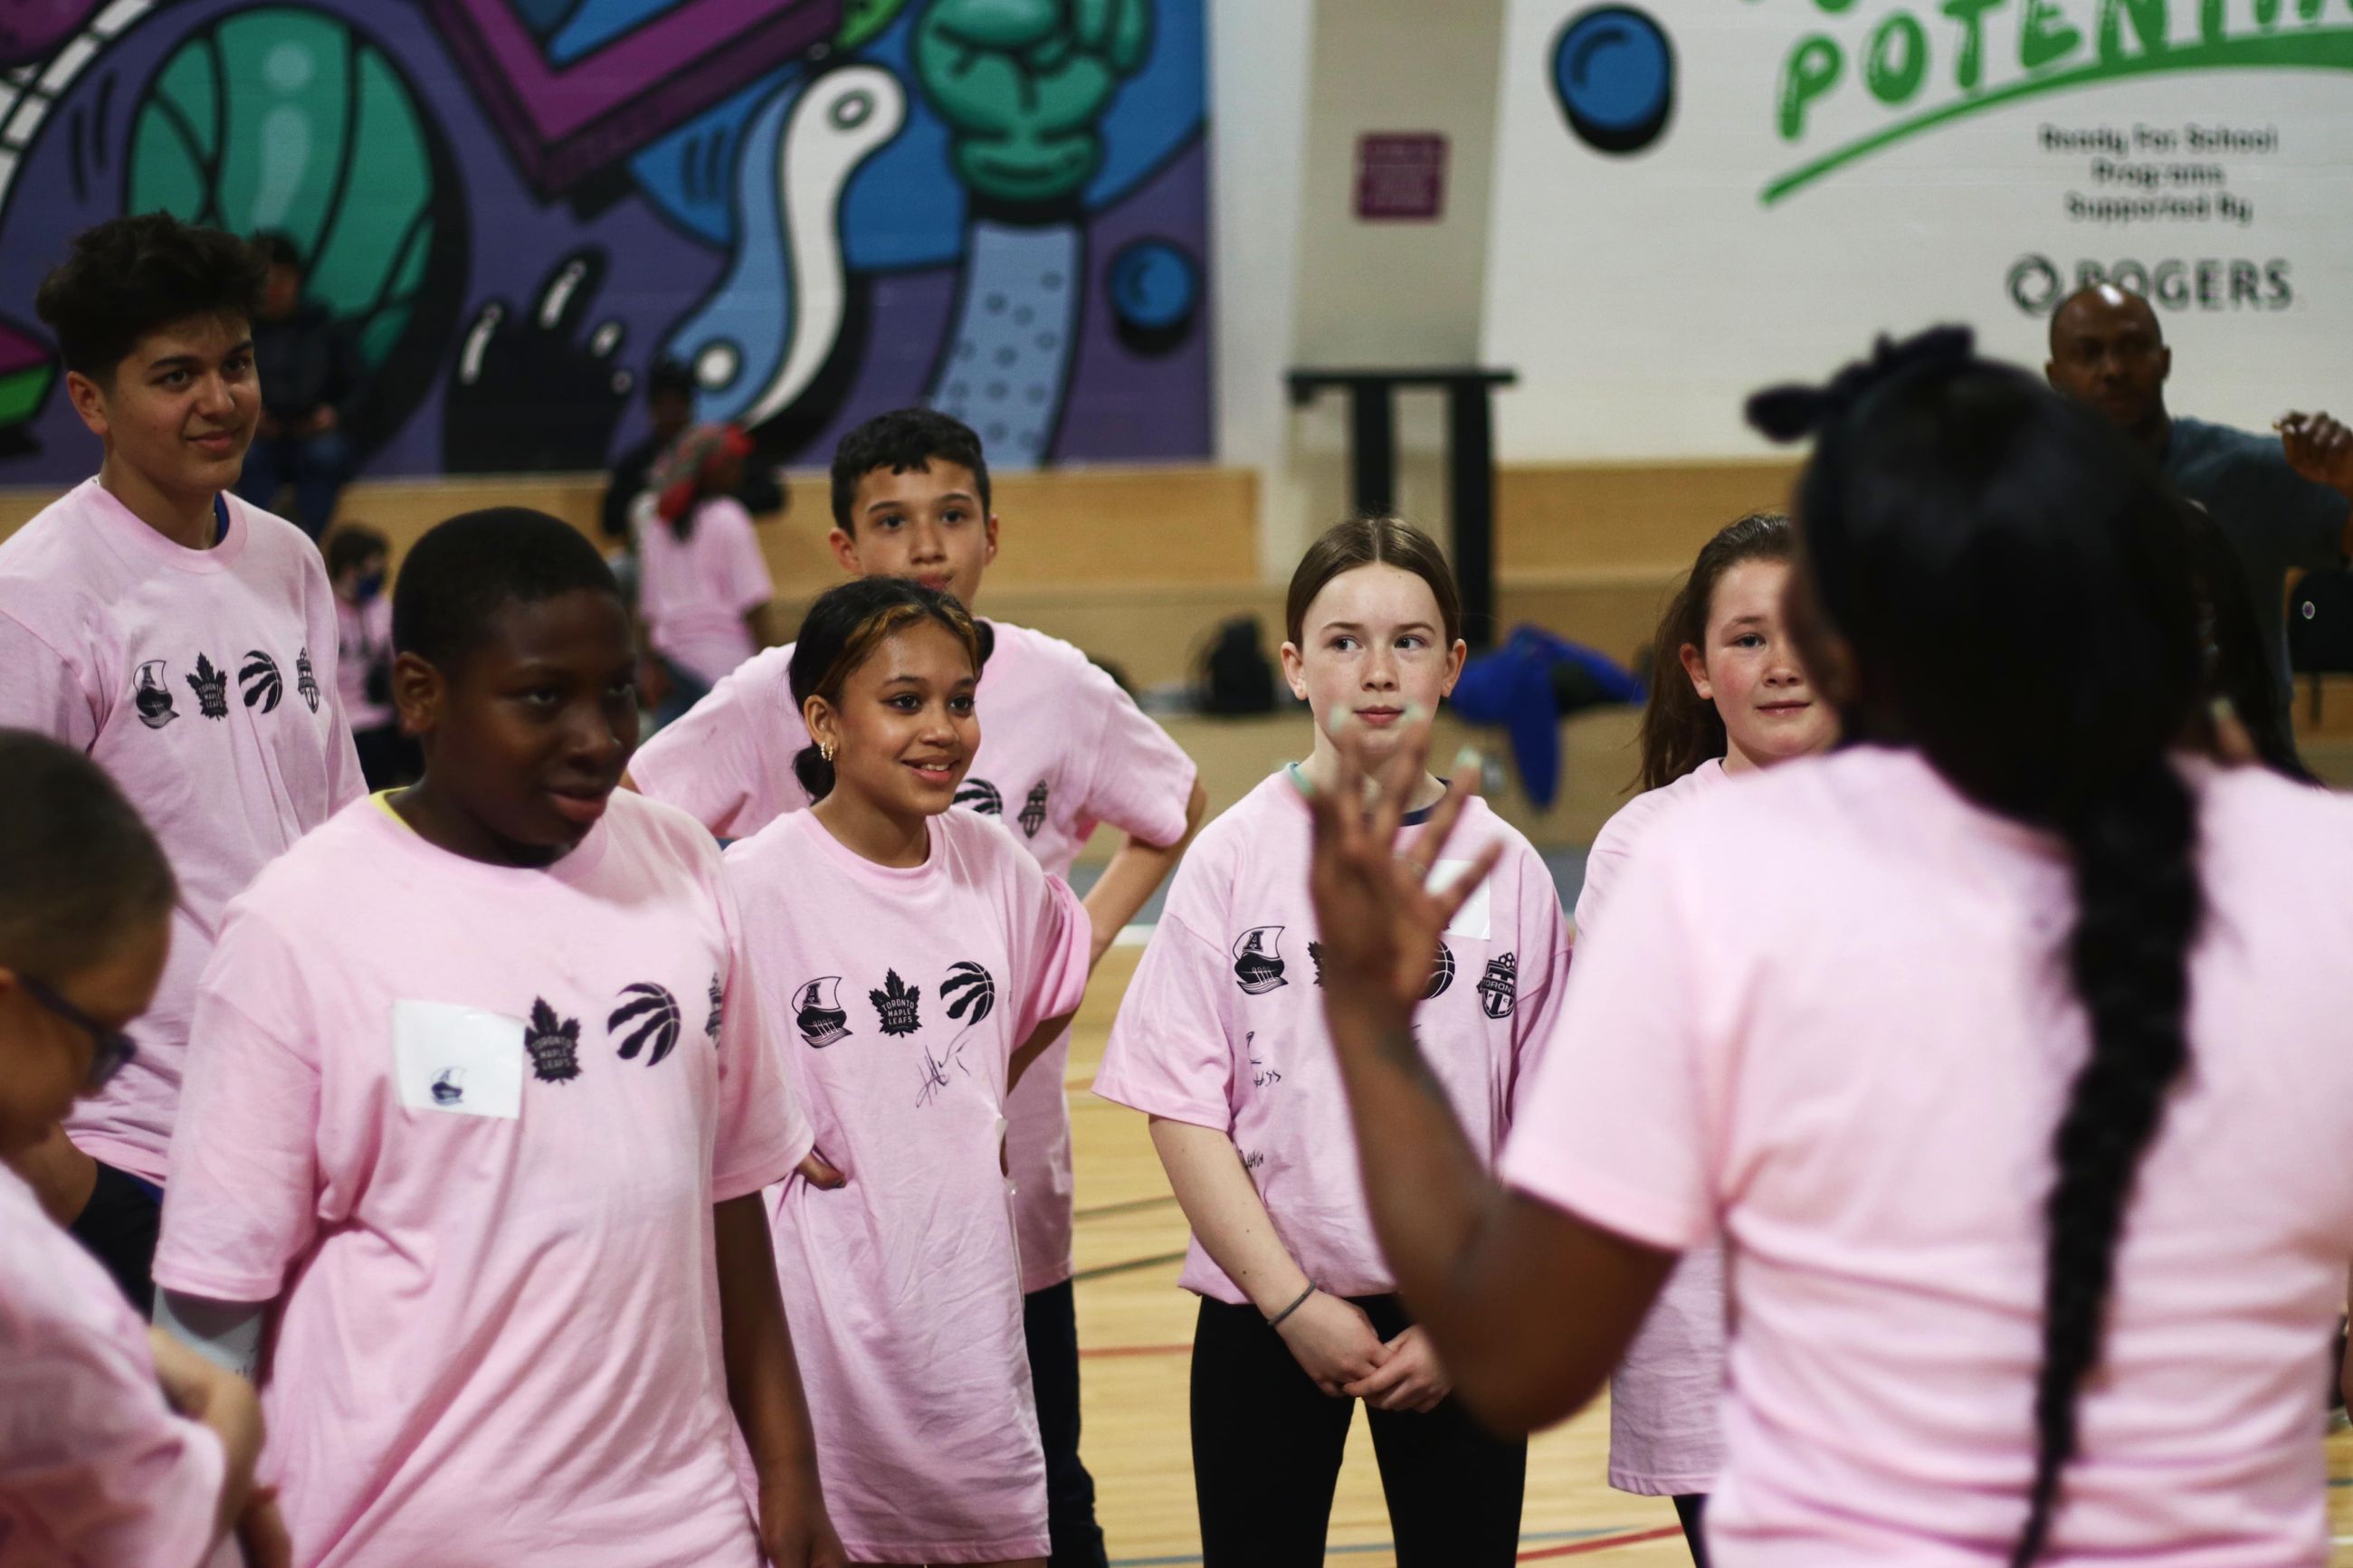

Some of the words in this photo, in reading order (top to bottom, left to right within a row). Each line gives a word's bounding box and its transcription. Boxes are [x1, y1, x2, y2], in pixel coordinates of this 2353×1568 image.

[2038, 123, 2129, 157] Ready
[2133, 123, 2177, 154] For
[2185, 123, 2278, 154] School
[2091, 157, 2224, 190] Programs
[2065, 190, 2209, 223] Supported
[2216, 191, 2253, 226] By
[881, 998, 915, 1012] TORONTO
[888, 1007, 911, 1017] MAPLE
[888, 1015, 913, 1025] LEAFS
